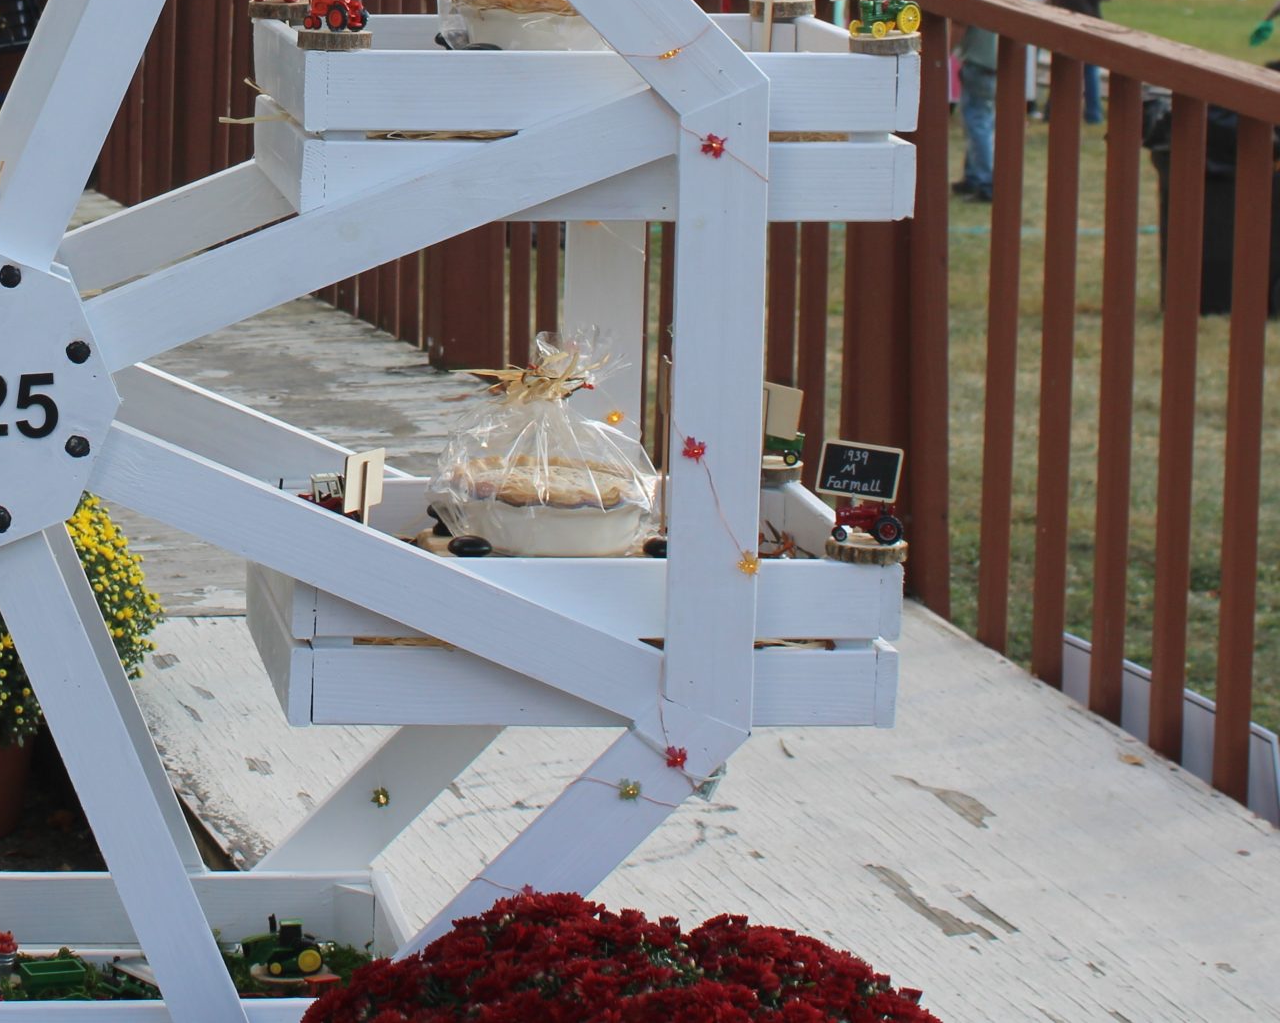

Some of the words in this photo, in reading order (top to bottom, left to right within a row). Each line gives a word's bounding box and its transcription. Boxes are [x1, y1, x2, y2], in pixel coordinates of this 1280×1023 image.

[843, 449, 869, 465] 1939
[840, 463, 856, 476] M
[827, 476, 881, 493] Farmall
